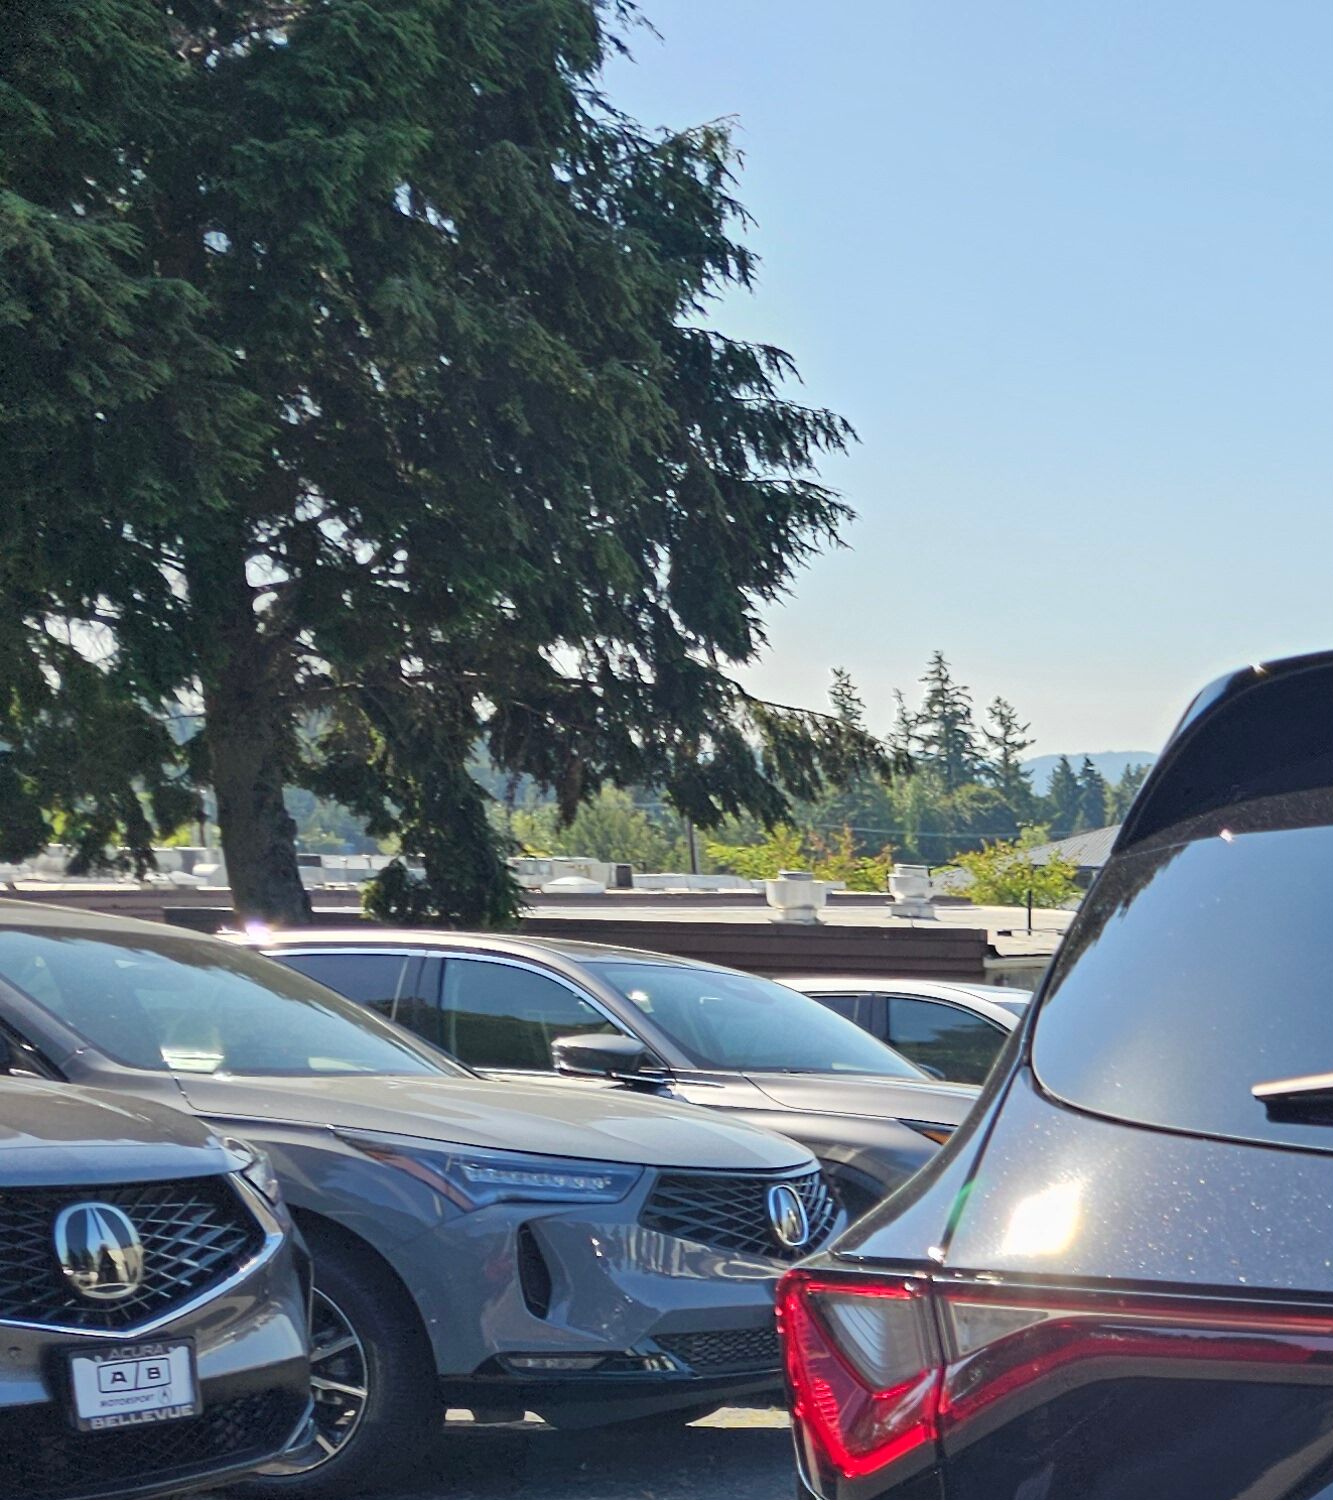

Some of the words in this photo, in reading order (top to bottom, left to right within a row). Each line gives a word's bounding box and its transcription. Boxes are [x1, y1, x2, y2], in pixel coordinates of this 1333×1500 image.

[107, 1343, 165, 1360] ACURA
[110, 1371, 128, 1384] A
[146, 1366, 161, 1379] B
[90, 1404, 194, 1430] BELLEVUE
